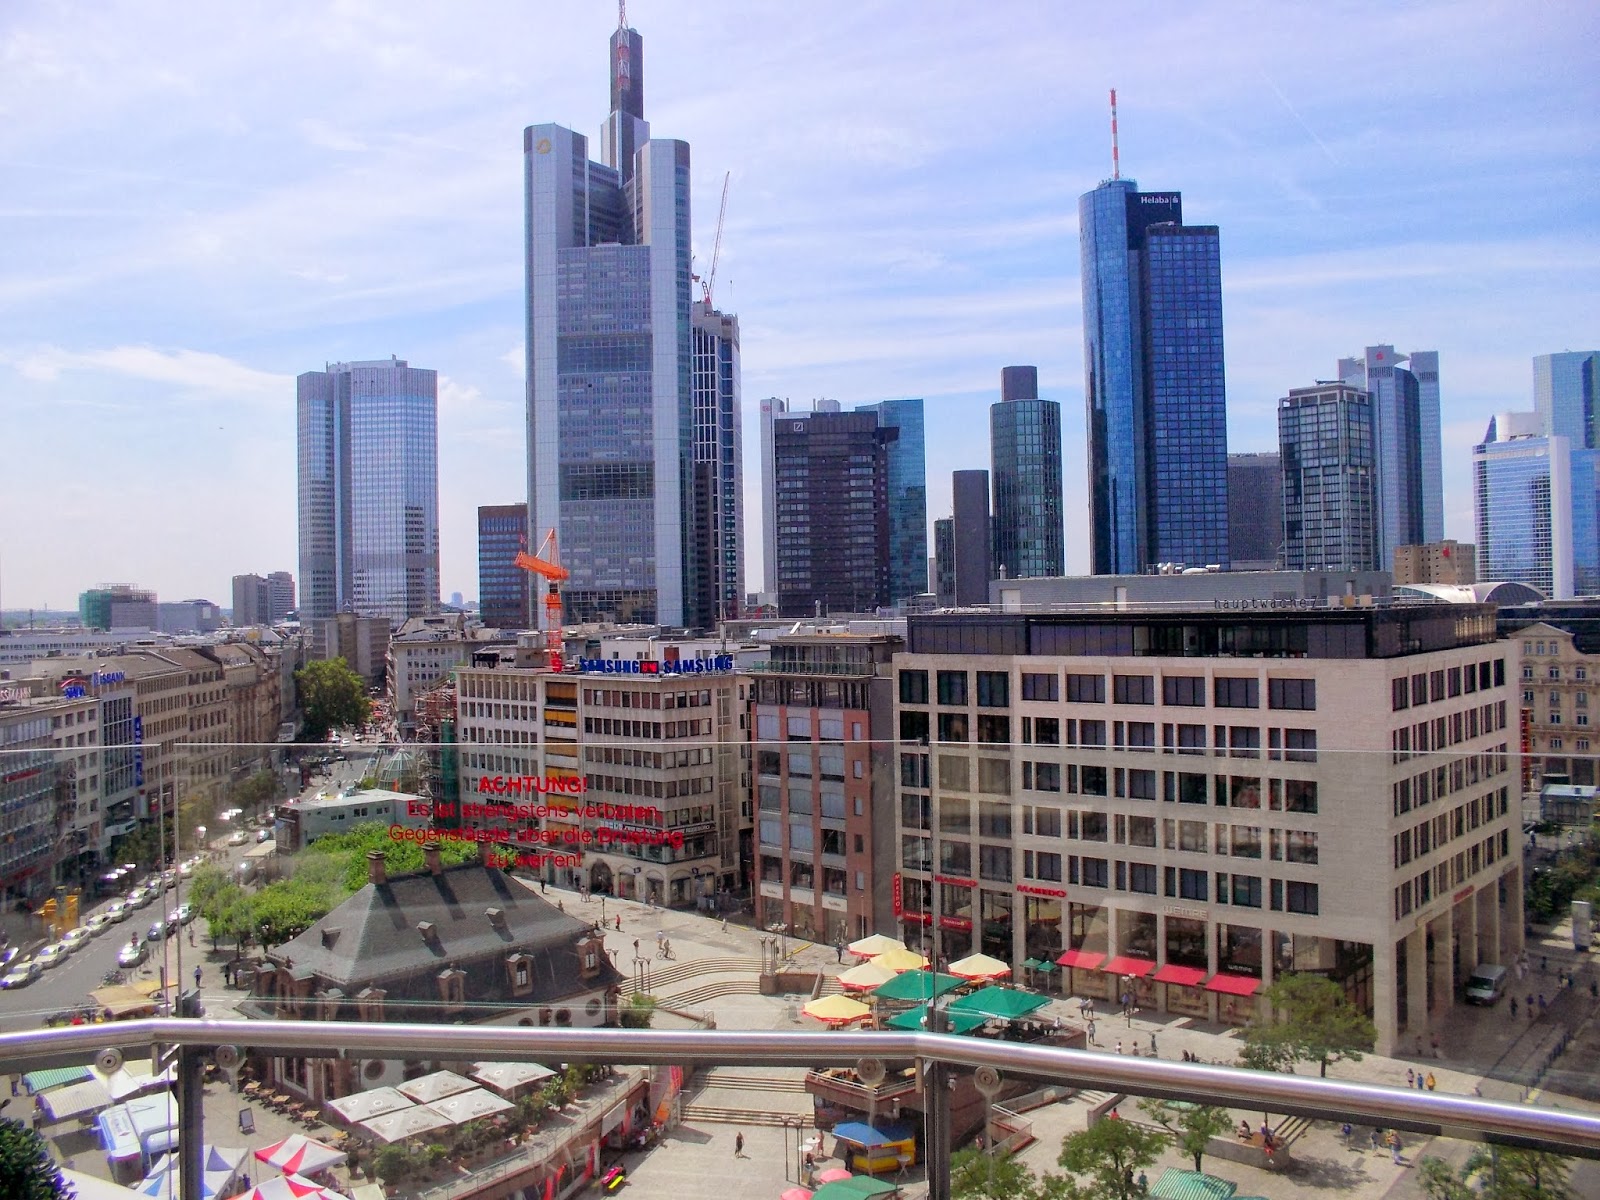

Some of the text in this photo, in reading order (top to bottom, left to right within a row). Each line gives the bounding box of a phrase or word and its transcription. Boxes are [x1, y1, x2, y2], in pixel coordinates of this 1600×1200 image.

[1140, 196, 1169, 204] Helaba
[579, 657, 639, 674] SAMSUNG
[663, 654, 733, 674] SAMSUNG
[478, 776, 588, 793] ACHTUNG!
[407, 800, 430, 817] Es
[434, 801, 456, 818] ist
[461, 802, 568, 823] strengstens
[388, 824, 510, 845] Gegenstände
[516, 825, 558, 844] über
[564, 826, 592, 844] die
[597, 827, 684, 850] Brüstung
[486, 852, 582, 869] zu werfen!
[1163, 905, 1209, 920] WEMPE
[1227, 963, 1254, 973] WEMPE
